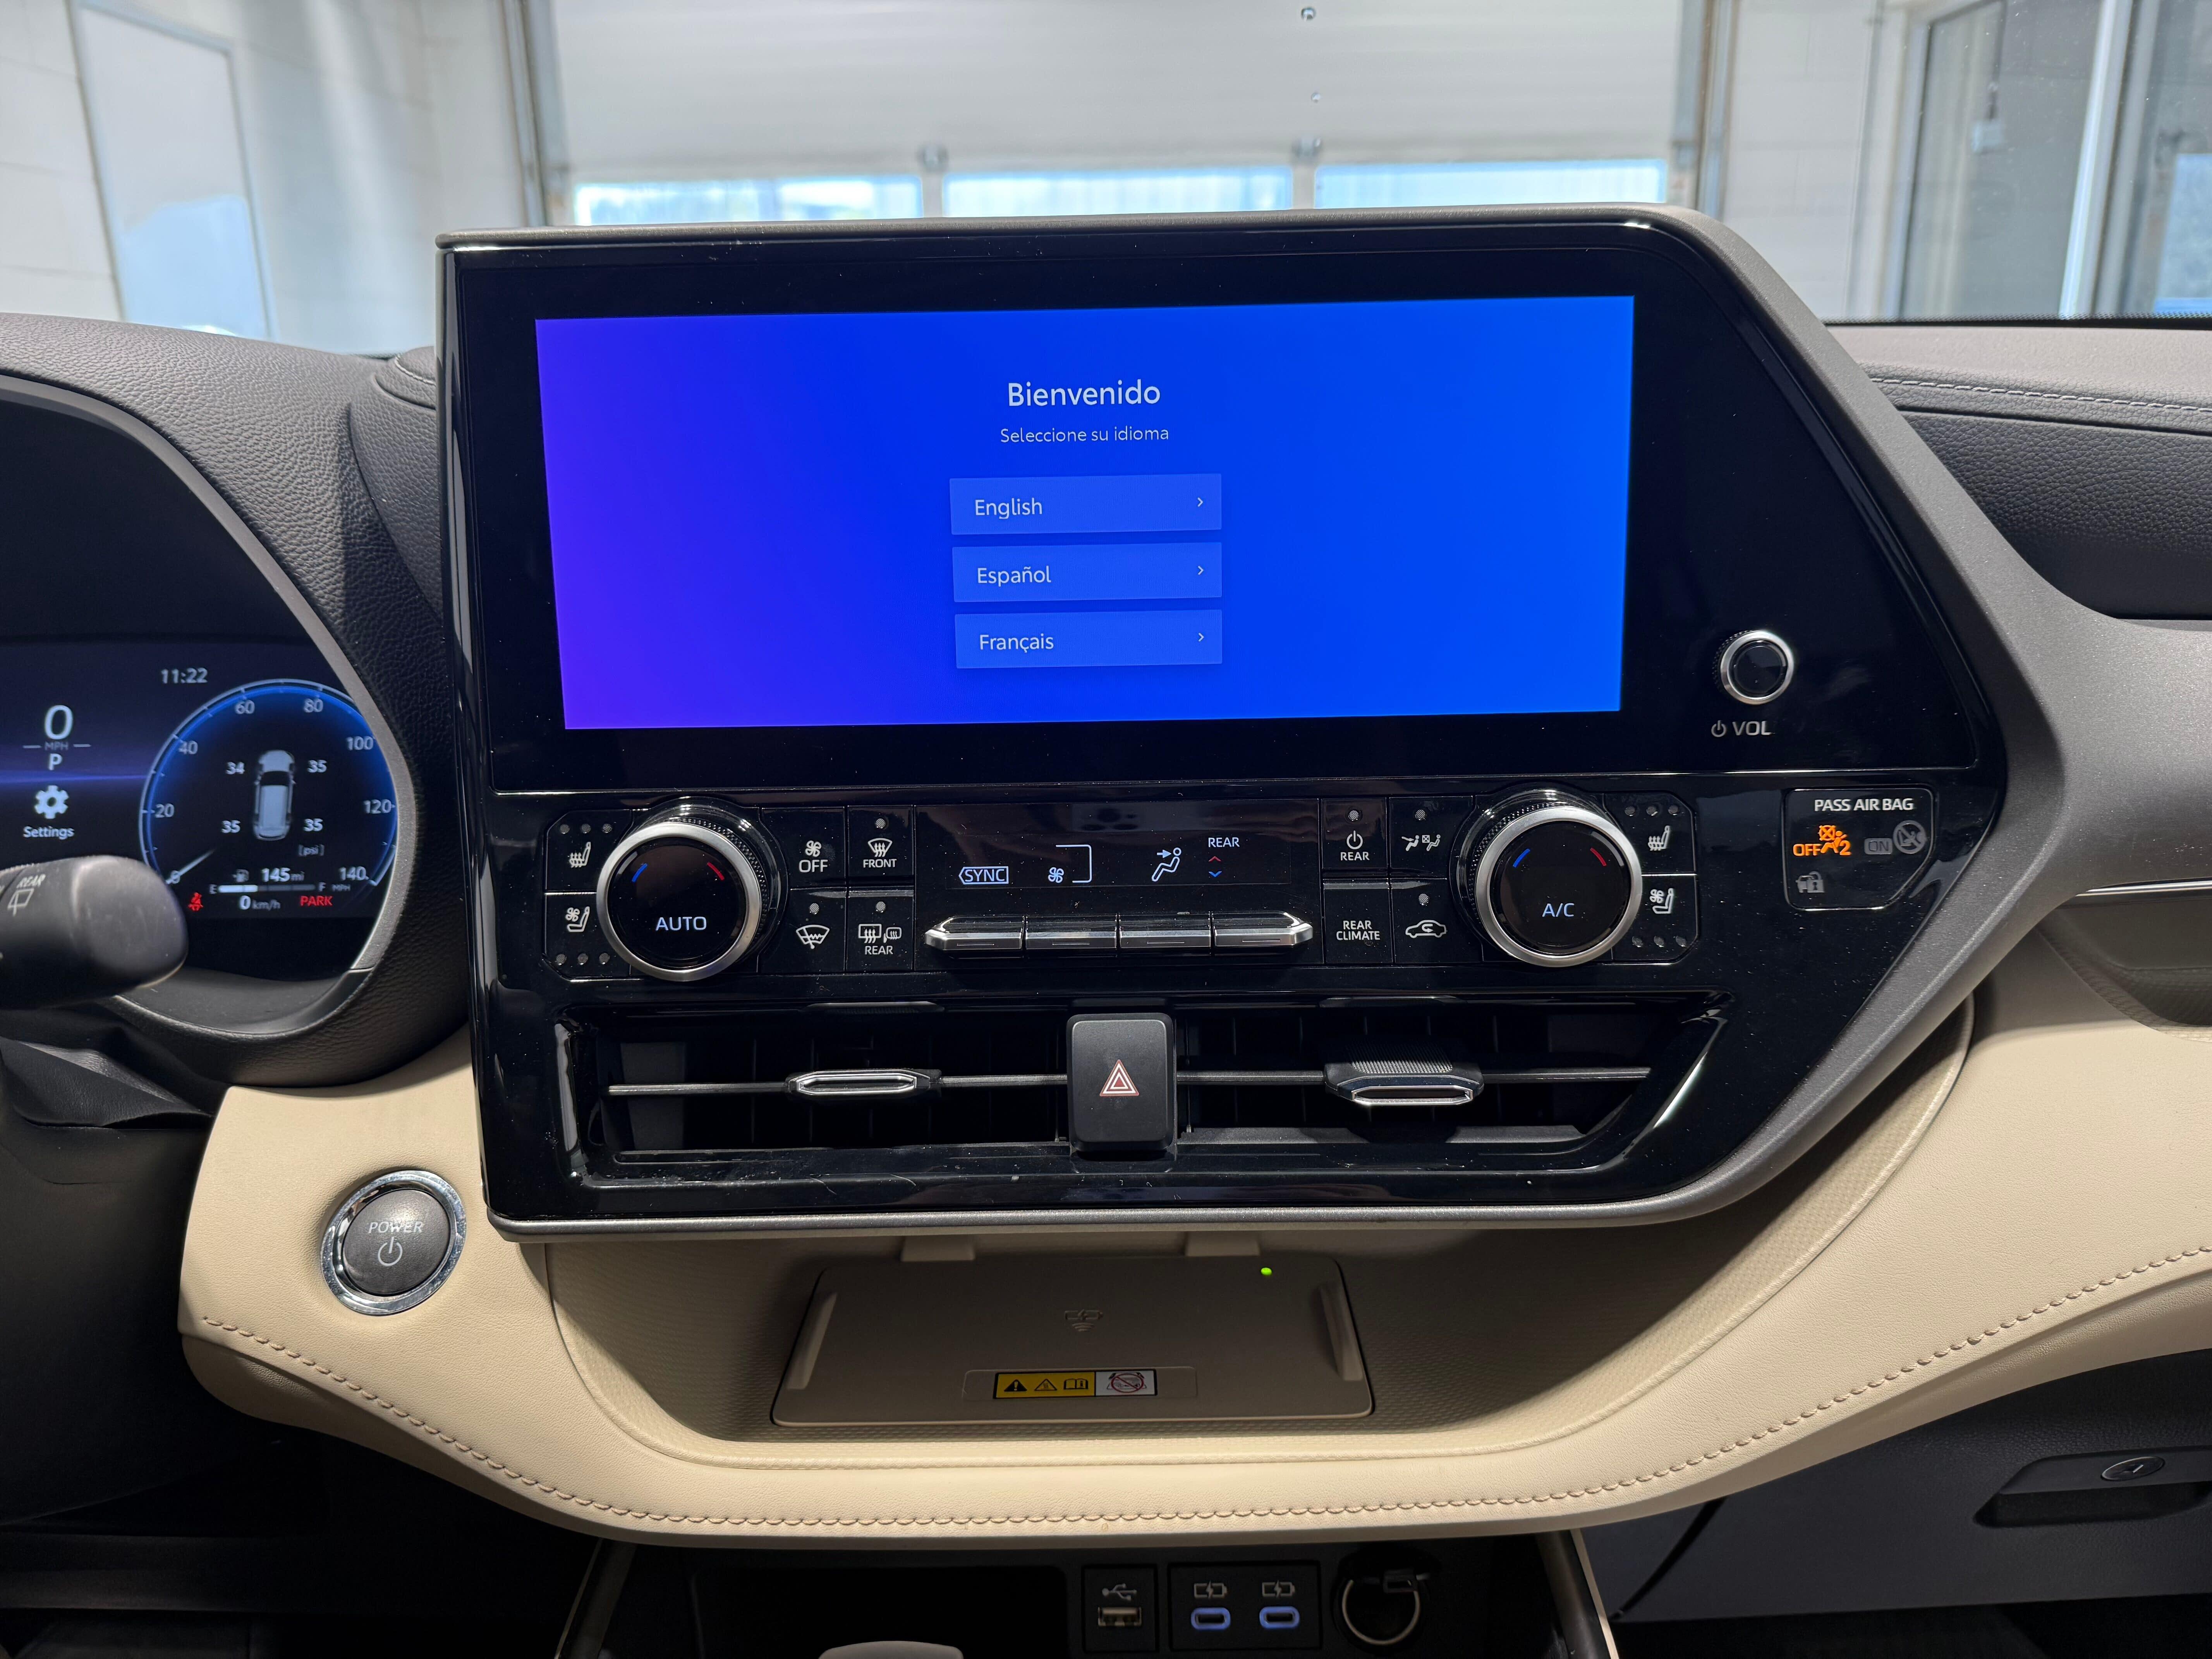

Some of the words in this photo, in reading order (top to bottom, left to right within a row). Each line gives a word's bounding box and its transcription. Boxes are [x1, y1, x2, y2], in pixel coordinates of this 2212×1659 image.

[1008, 379, 1160, 406] Bienvenido
[1001, 427, 1087, 443] Seleccione
[1091, 430, 1108, 441] su
[1115, 425, 1168, 441] idioma
[975, 497, 1042, 519] English
[977, 565, 1051, 587] Español
[980, 633, 1054, 653] Français
[161, 668, 208, 684] 11:22
[235, 700, 255, 714] 60
[304, 699, 323, 713] 80
[45, 705, 73, 740] 0
[1732, 721, 1771, 735] VOL
[45, 742, 69, 751] MPH
[179, 740, 198, 754] 40
[347, 736, 373, 750] 100
[48, 753, 62, 771] P
[227, 762, 245, 775] 34
[308, 760, 327, 773] 35
[155, 804, 175, 818] 20
[364, 800, 392, 814] 120
[1815, 799, 1851, 811] PASS
[1853, 799, 1880, 811] AIR
[1882, 798, 1913, 811] BAG
[222, 820, 240, 833] 35
[304, 818, 323, 831] 35
[24, 826, 74, 840] Settings
[1208, 837, 1240, 847] REAR
[1793, 843, 1822, 856] OFF
[1839, 840, 1852, 856] 2
[1868, 840, 1889, 852] ON
[863, 858, 897, 868] FRONT
[1340, 852, 1370, 861] REAR
[799, 859, 828, 872] OFF
[16, 873, 46, 888] REAR
[261, 867, 291, 882] 145
[291, 871, 304, 881] mi
[339, 866, 366, 881] 140
[965, 869, 1005, 882] SYNC
[209, 884, 217, 894] E
[319, 882, 326, 891] F
[240, 895, 251, 910] 0
[252, 900, 280, 910] km/h
[300, 895, 332, 906] PARK
[1542, 903, 1574, 917] A/C
[656, 916, 707, 931] AUTO
[1343, 920, 1372, 930] REAR
[1336, 931, 1380, 941] CLIMATE
[865, 945, 893, 955] REAR
[368, 1221, 423, 1234] POWER
